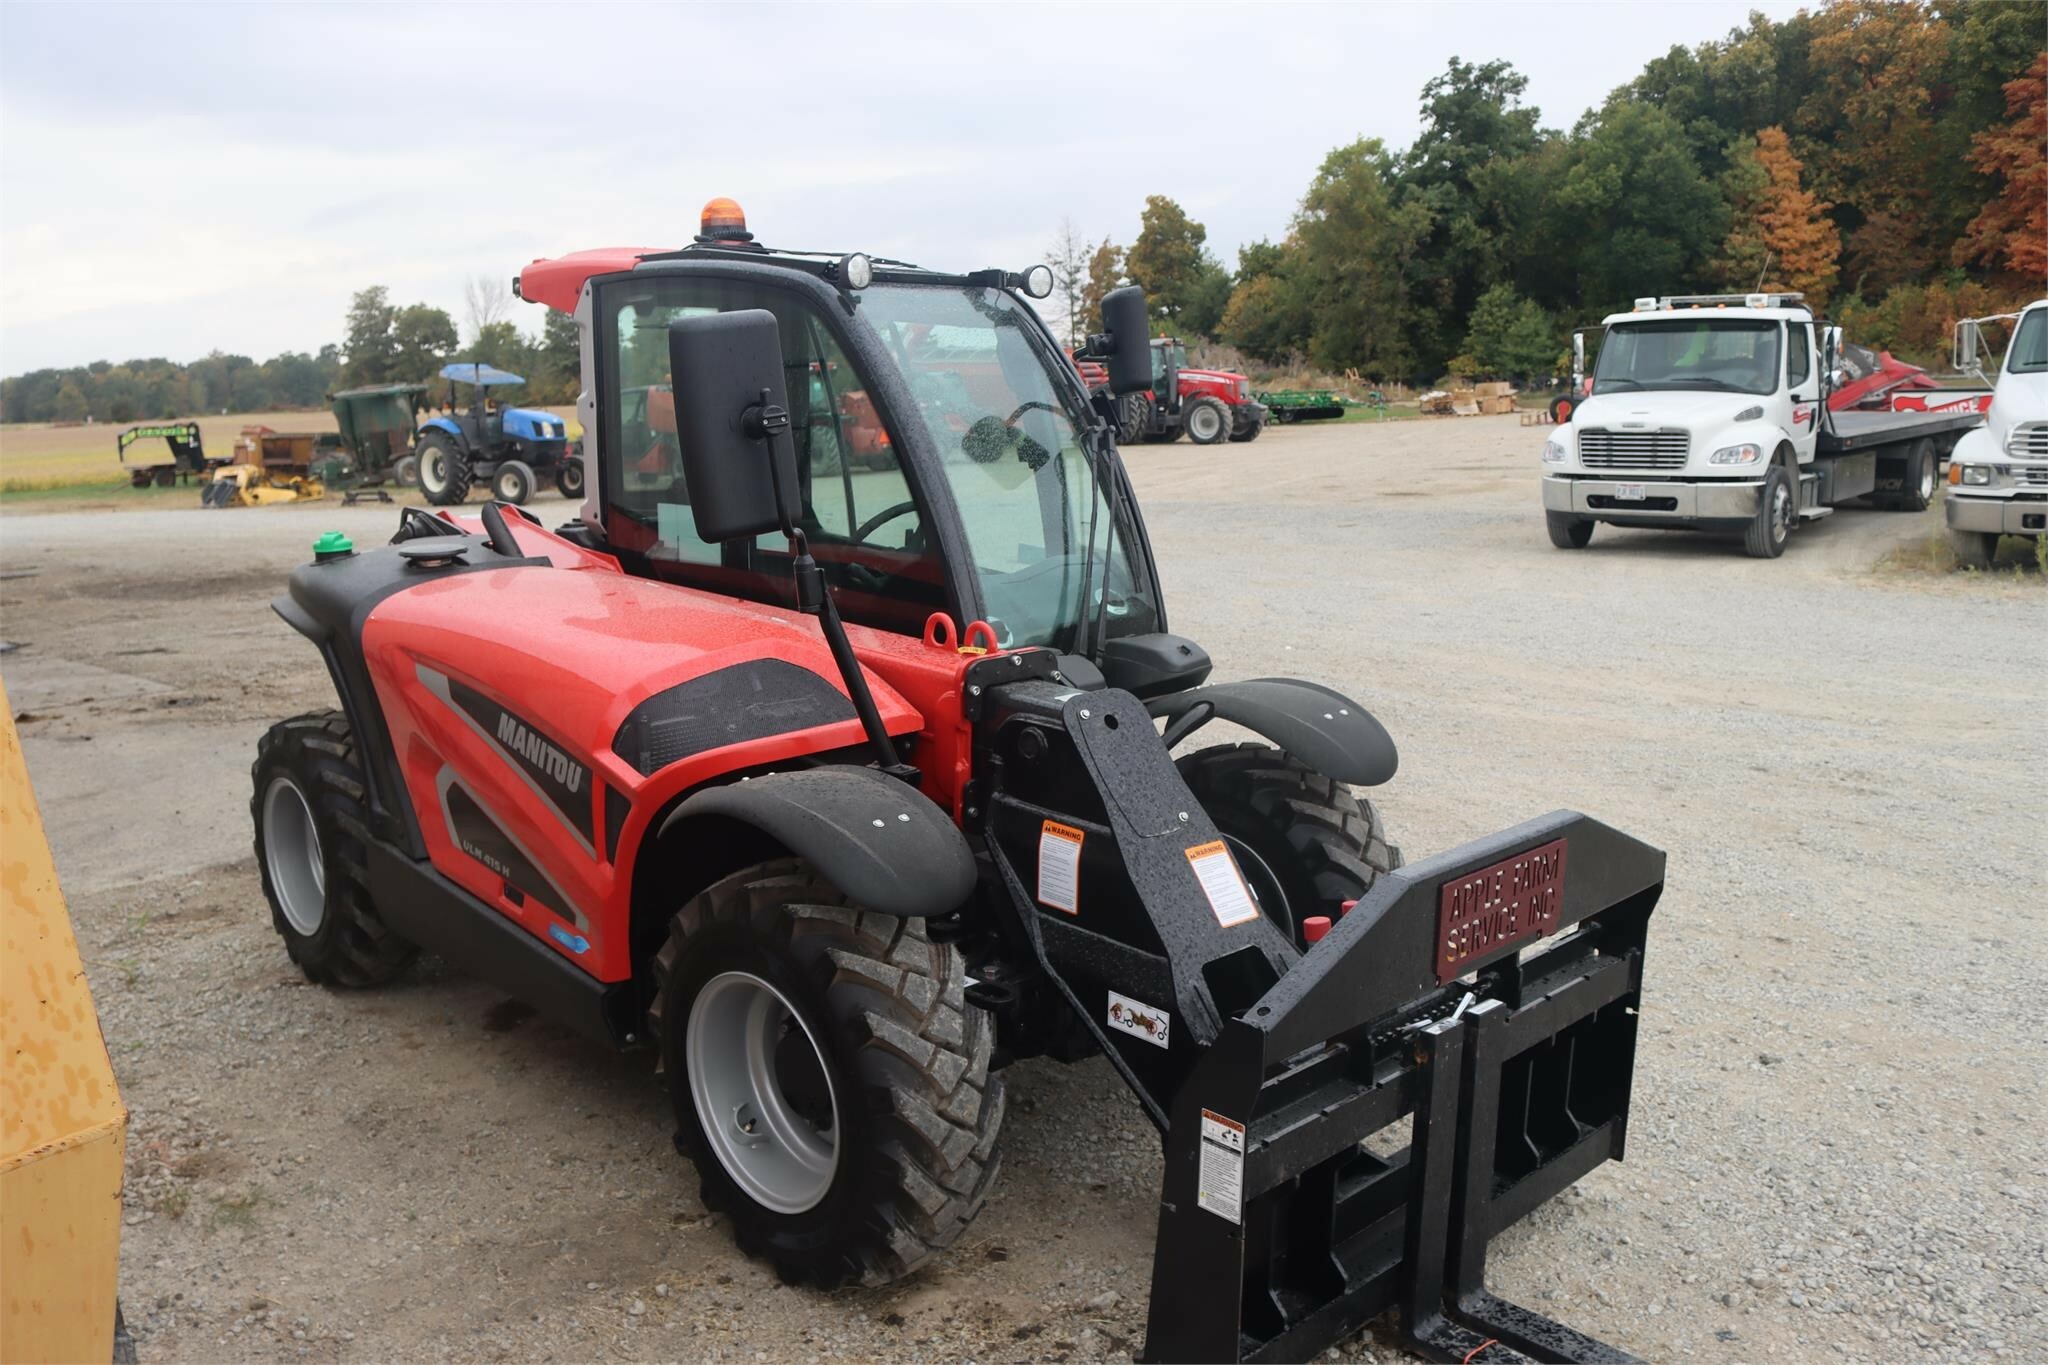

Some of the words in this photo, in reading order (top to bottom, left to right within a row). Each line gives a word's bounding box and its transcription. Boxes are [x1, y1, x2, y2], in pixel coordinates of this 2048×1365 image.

[497, 712, 583, 793] MANITOU
[1051, 826, 1081, 841] WARNING
[1195, 844, 1223, 857] WARNING
[1450, 870, 1504, 922] APPLE
[1513, 848, 1560, 897] FARM
[1447, 901, 1520, 962] SERVICE
[1528, 887, 1556, 927] INC
